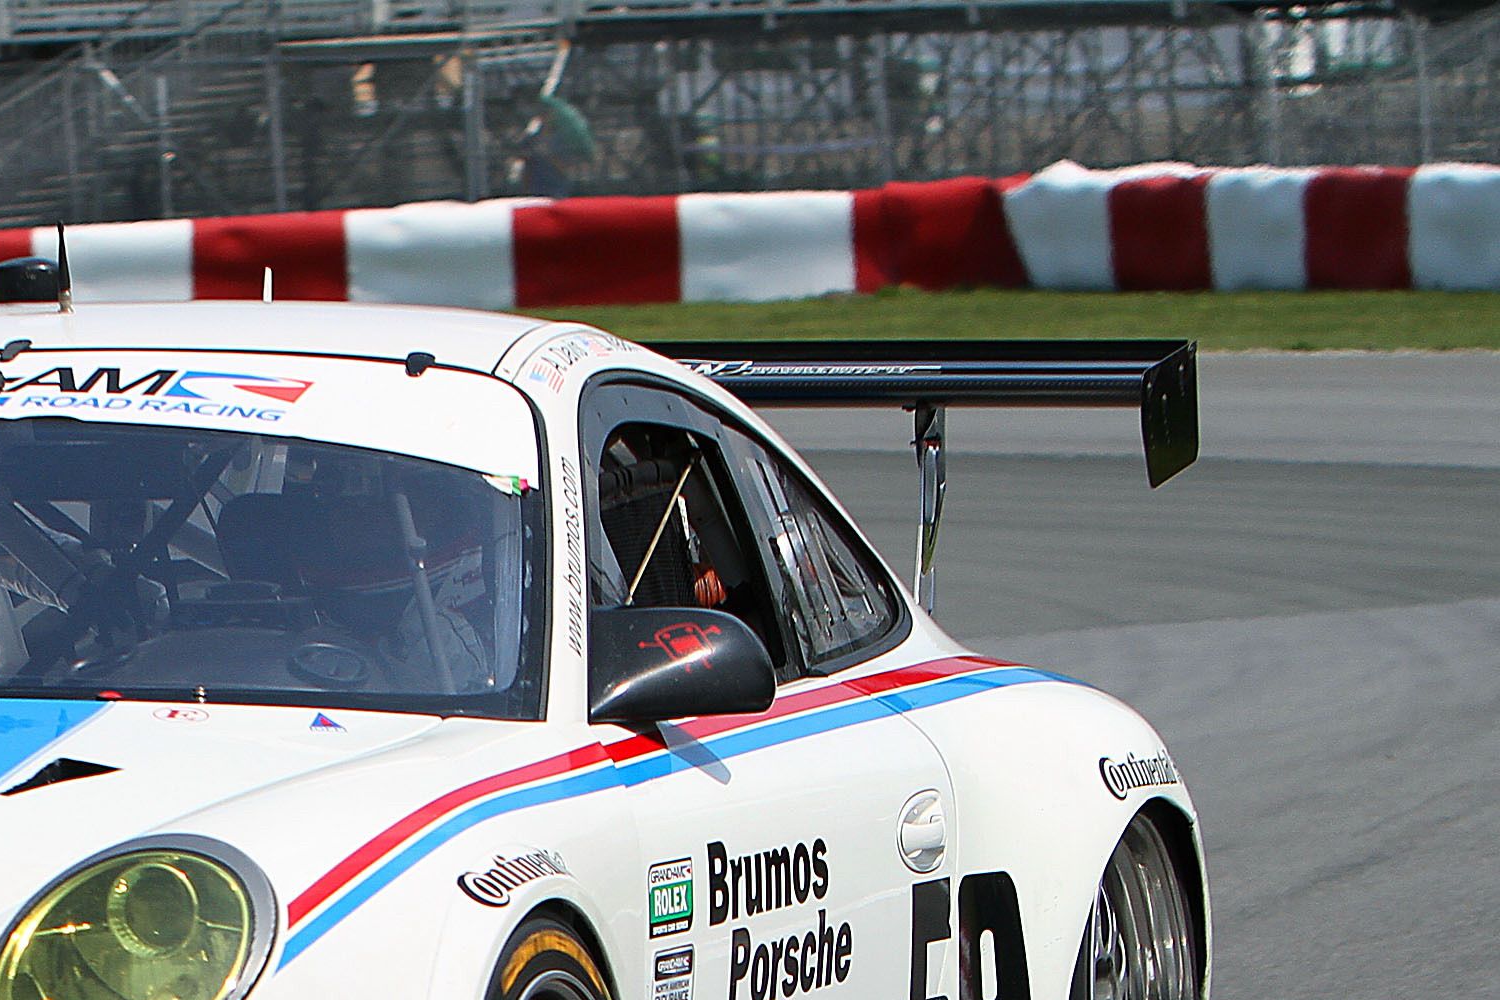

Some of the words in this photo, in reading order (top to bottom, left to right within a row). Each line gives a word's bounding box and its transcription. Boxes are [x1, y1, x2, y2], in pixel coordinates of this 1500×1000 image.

[20, 395, 132, 410] ROAD
[143, 399, 287, 421] RACING
[561, 456, 583, 658] www.brumos.com
[654, 884, 688, 917] ROLEX
[707, 838, 829, 927] Brumos
